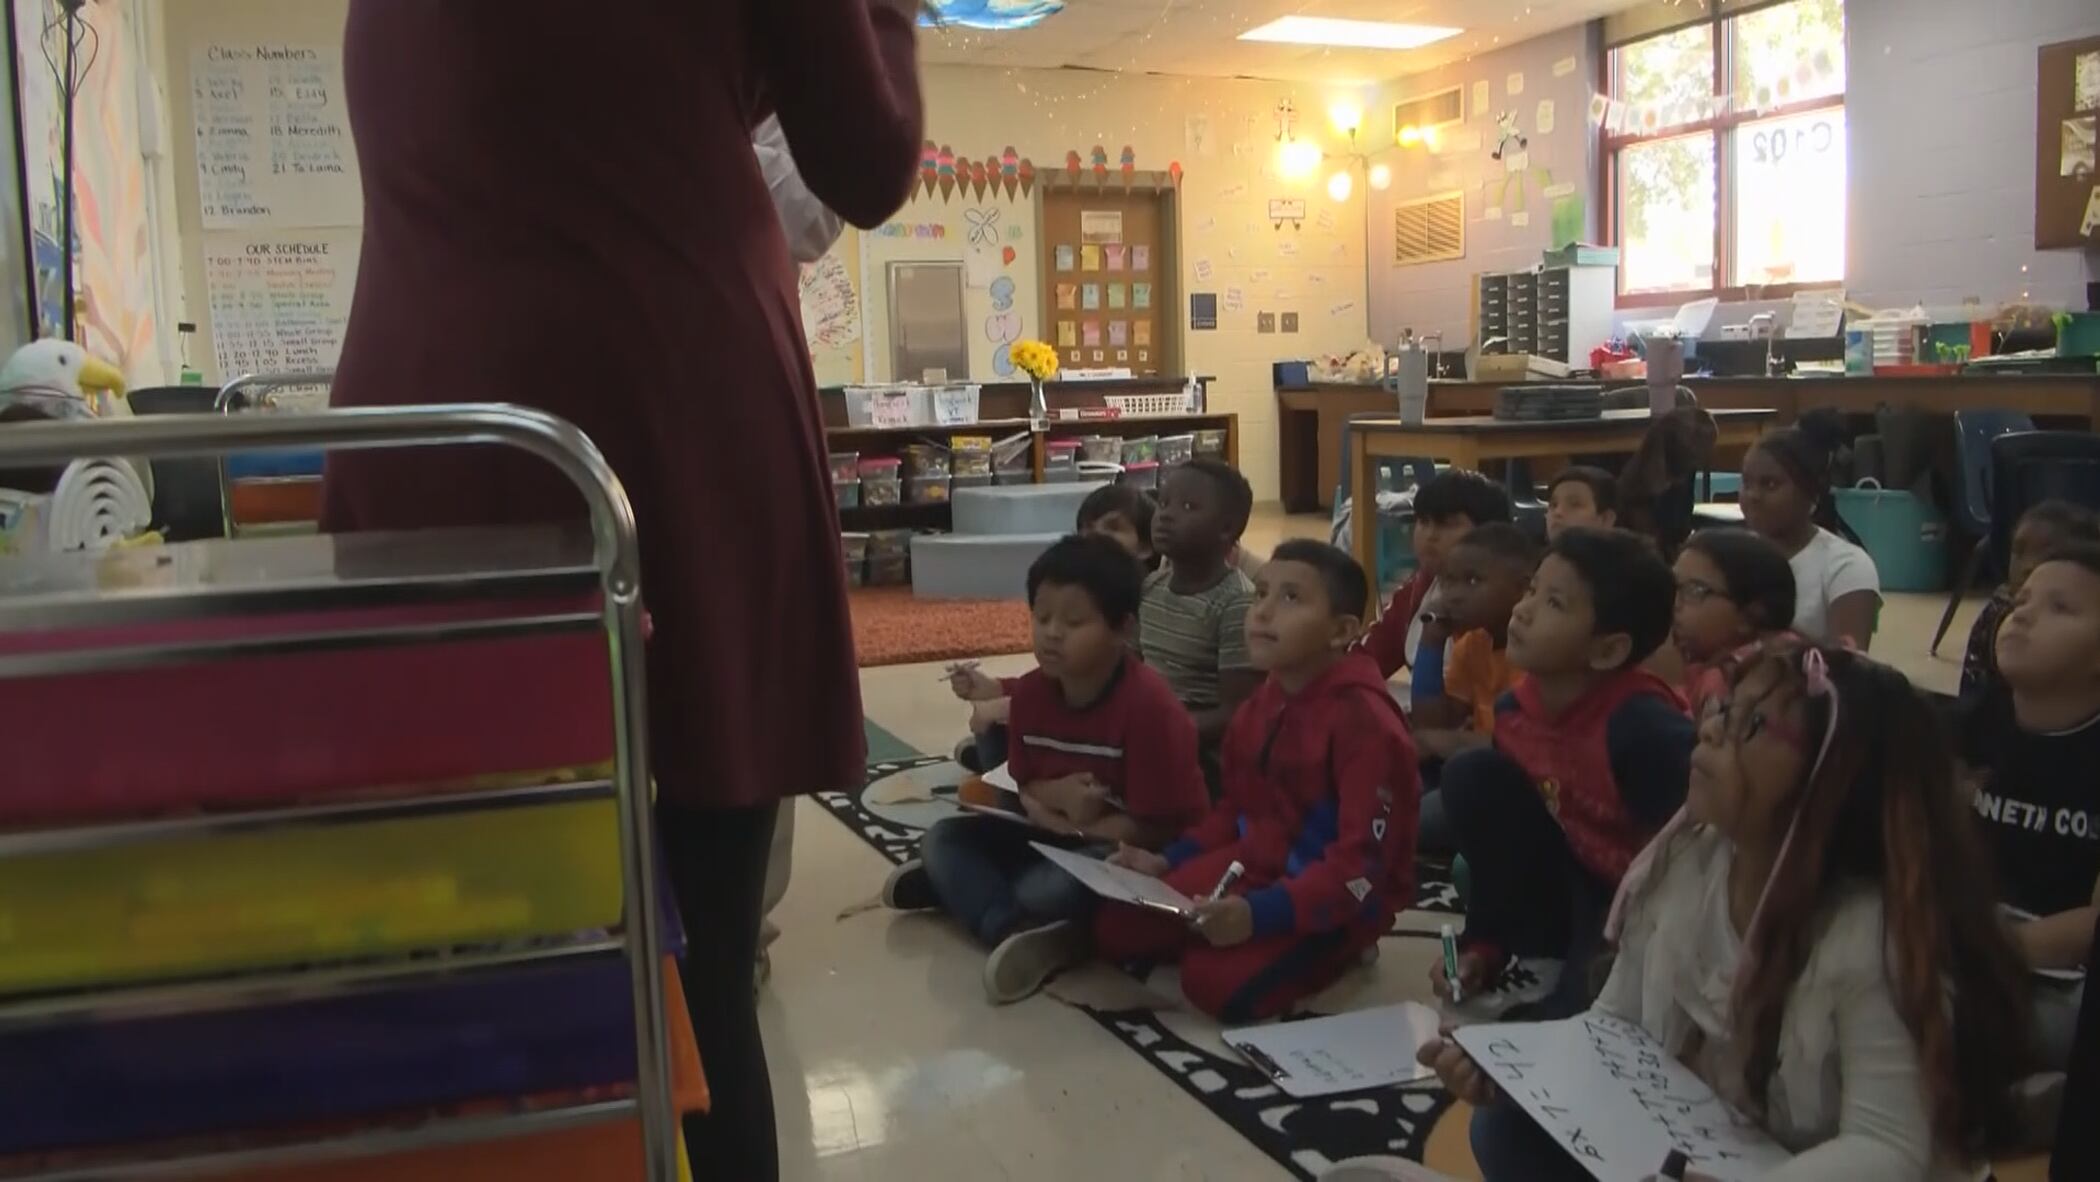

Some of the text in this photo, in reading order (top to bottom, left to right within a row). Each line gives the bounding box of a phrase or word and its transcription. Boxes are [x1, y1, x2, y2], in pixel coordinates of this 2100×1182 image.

[208, 45, 317, 61] Class Numbers
[288, 125, 341, 136] Meredith
[222, 205, 271, 217] Brandon
[246, 243, 329, 255] OUR SCHEDULE
